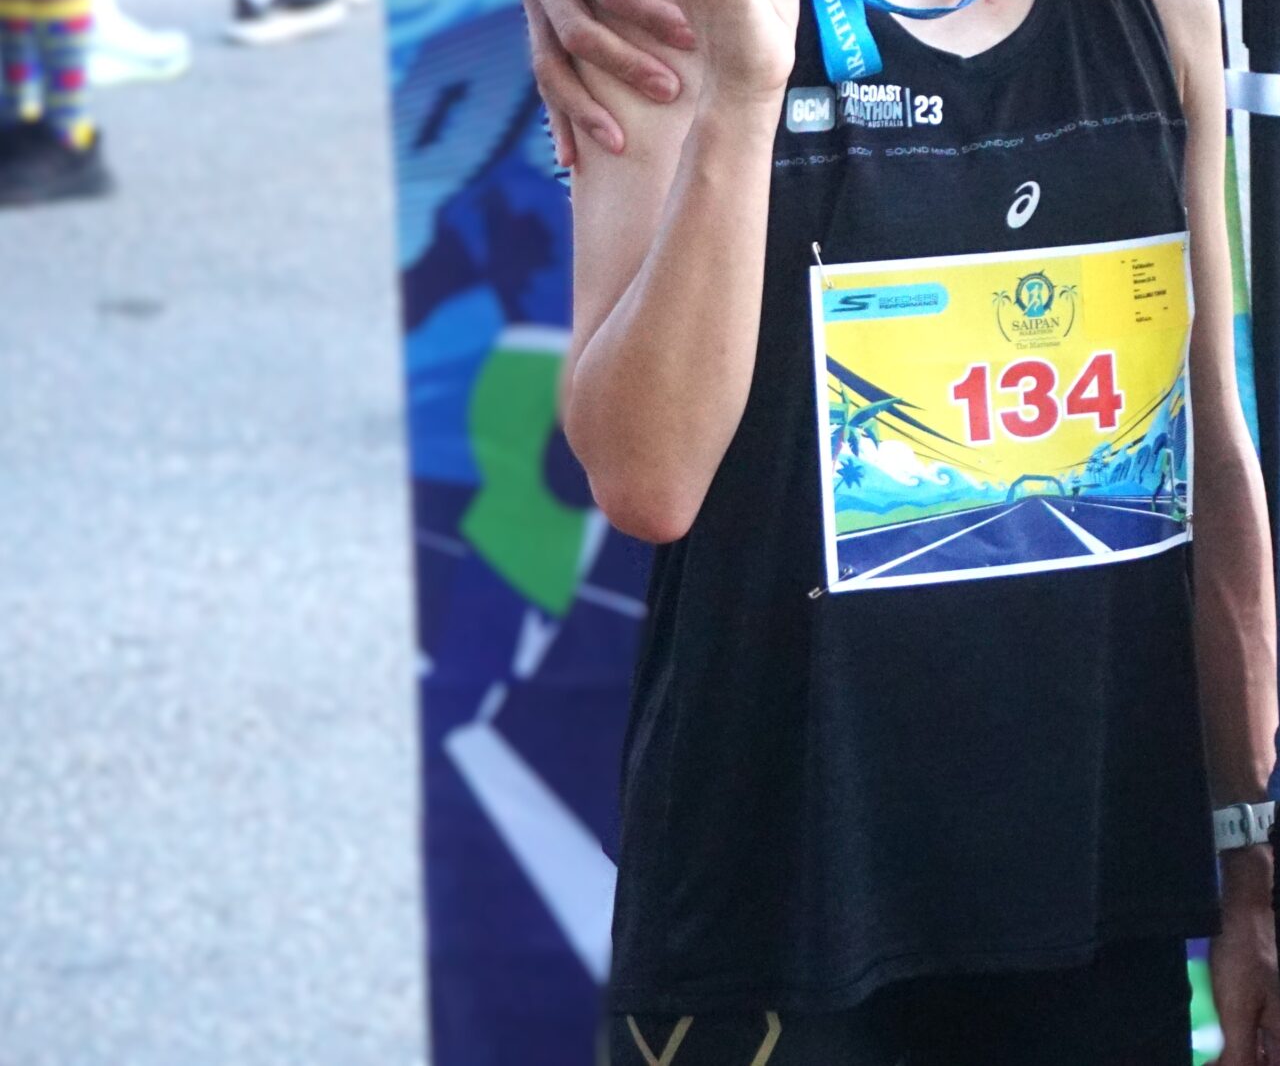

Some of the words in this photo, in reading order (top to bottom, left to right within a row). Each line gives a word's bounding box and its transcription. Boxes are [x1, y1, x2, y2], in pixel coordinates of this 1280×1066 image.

[860, 84, 901, 102] COAST
[793, 97, 830, 123] GCM
[914, 95, 944, 125] 23
[885, 146, 929, 157] SOUND
[1034, 122, 1077, 142] SOUND
[1012, 317, 1060, 331] SAIPAN
[953, 353, 1122, 442] 134
